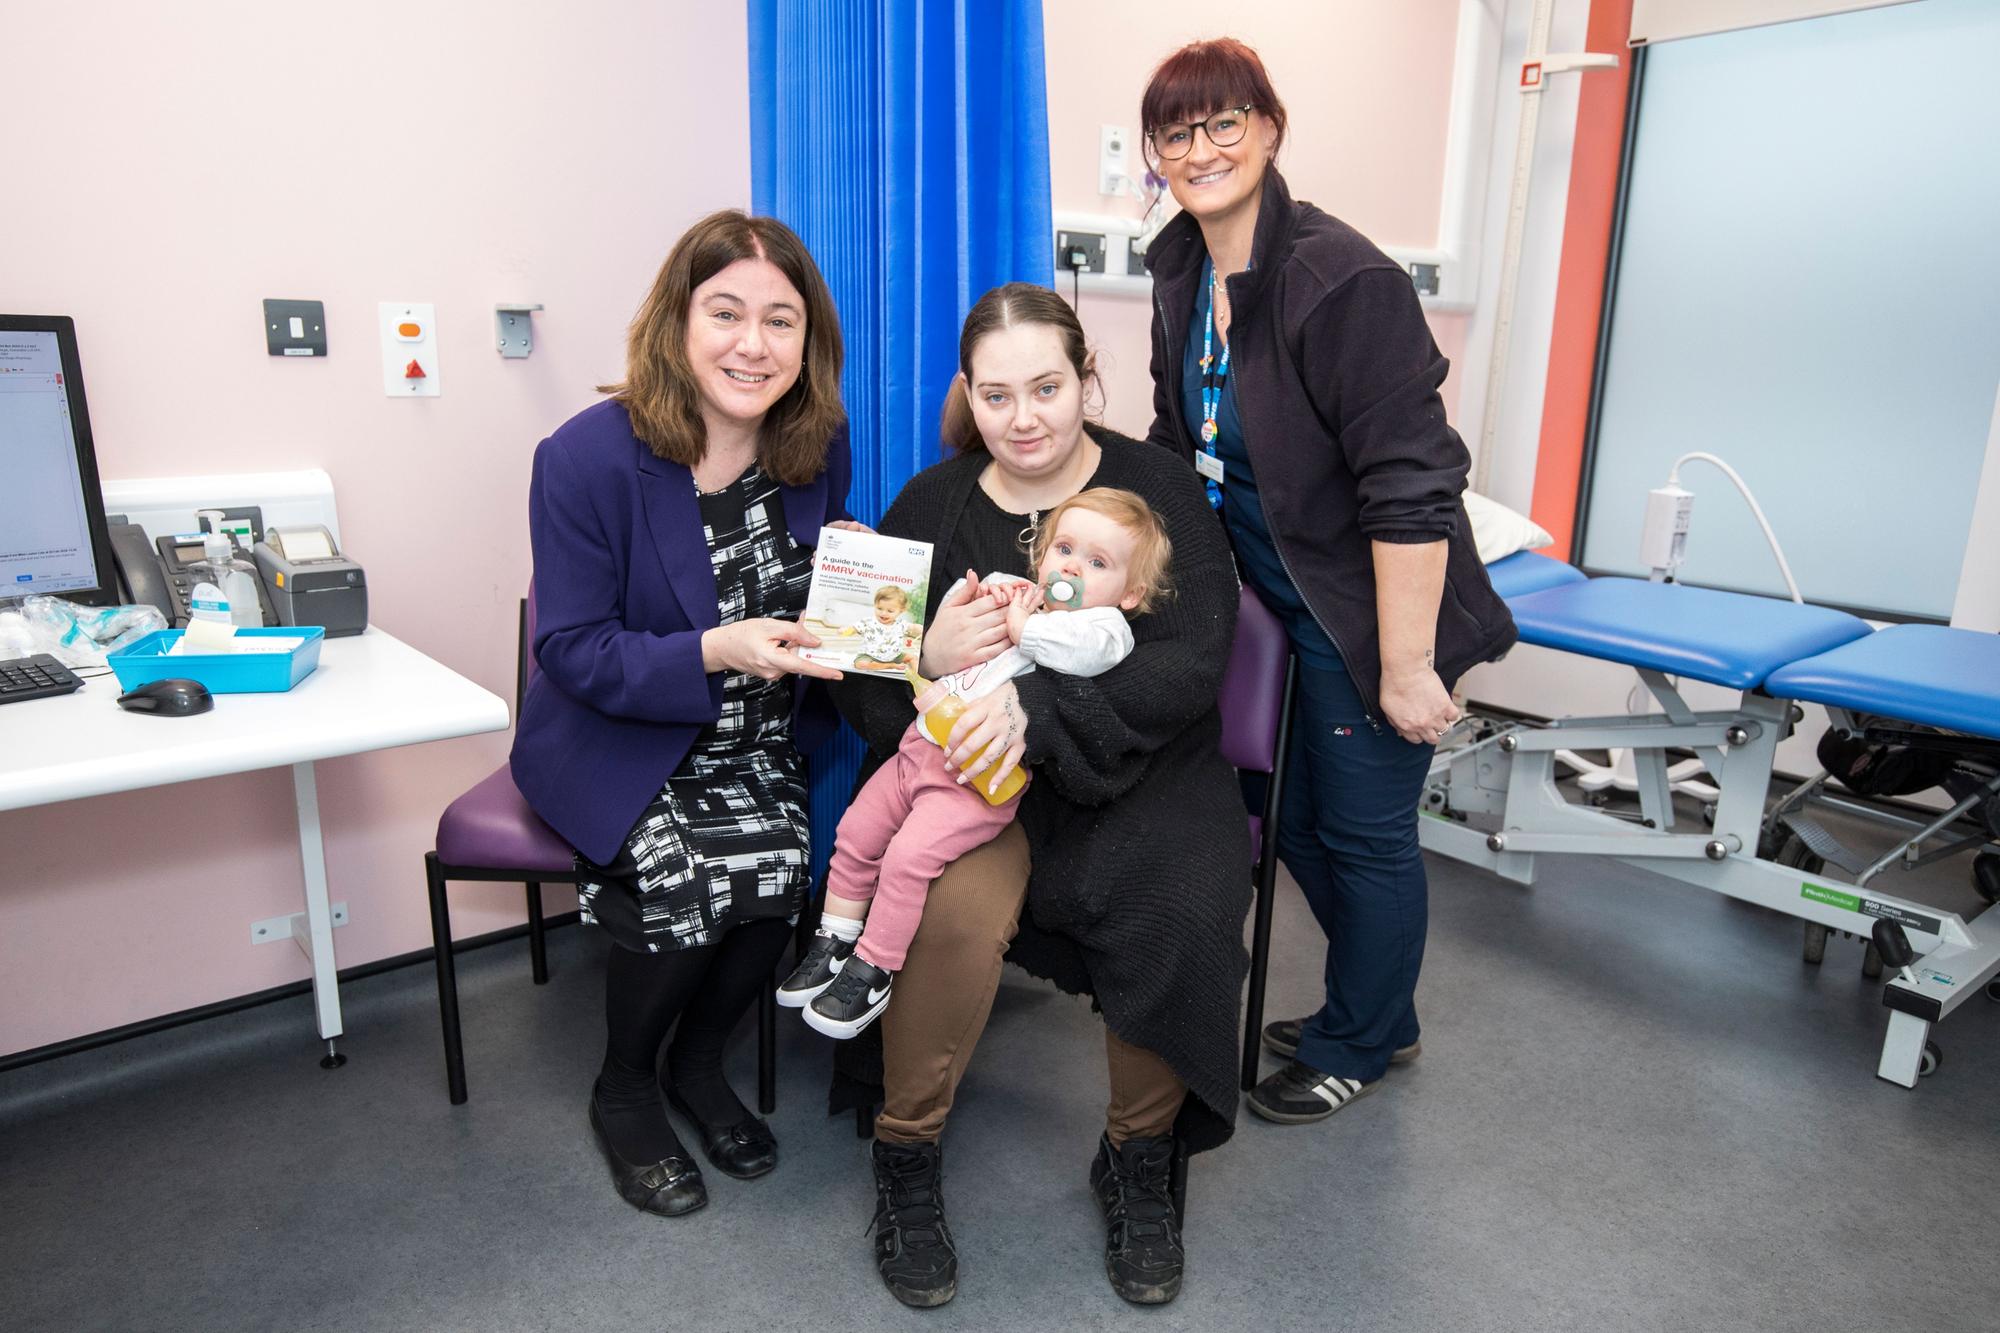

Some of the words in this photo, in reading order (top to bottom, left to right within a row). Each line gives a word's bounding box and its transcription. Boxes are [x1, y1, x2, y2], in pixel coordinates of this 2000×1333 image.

[830, 557, 851, 566] guide
[821, 563, 855, 576] MMRV
[857, 570, 914, 585] vaccination
